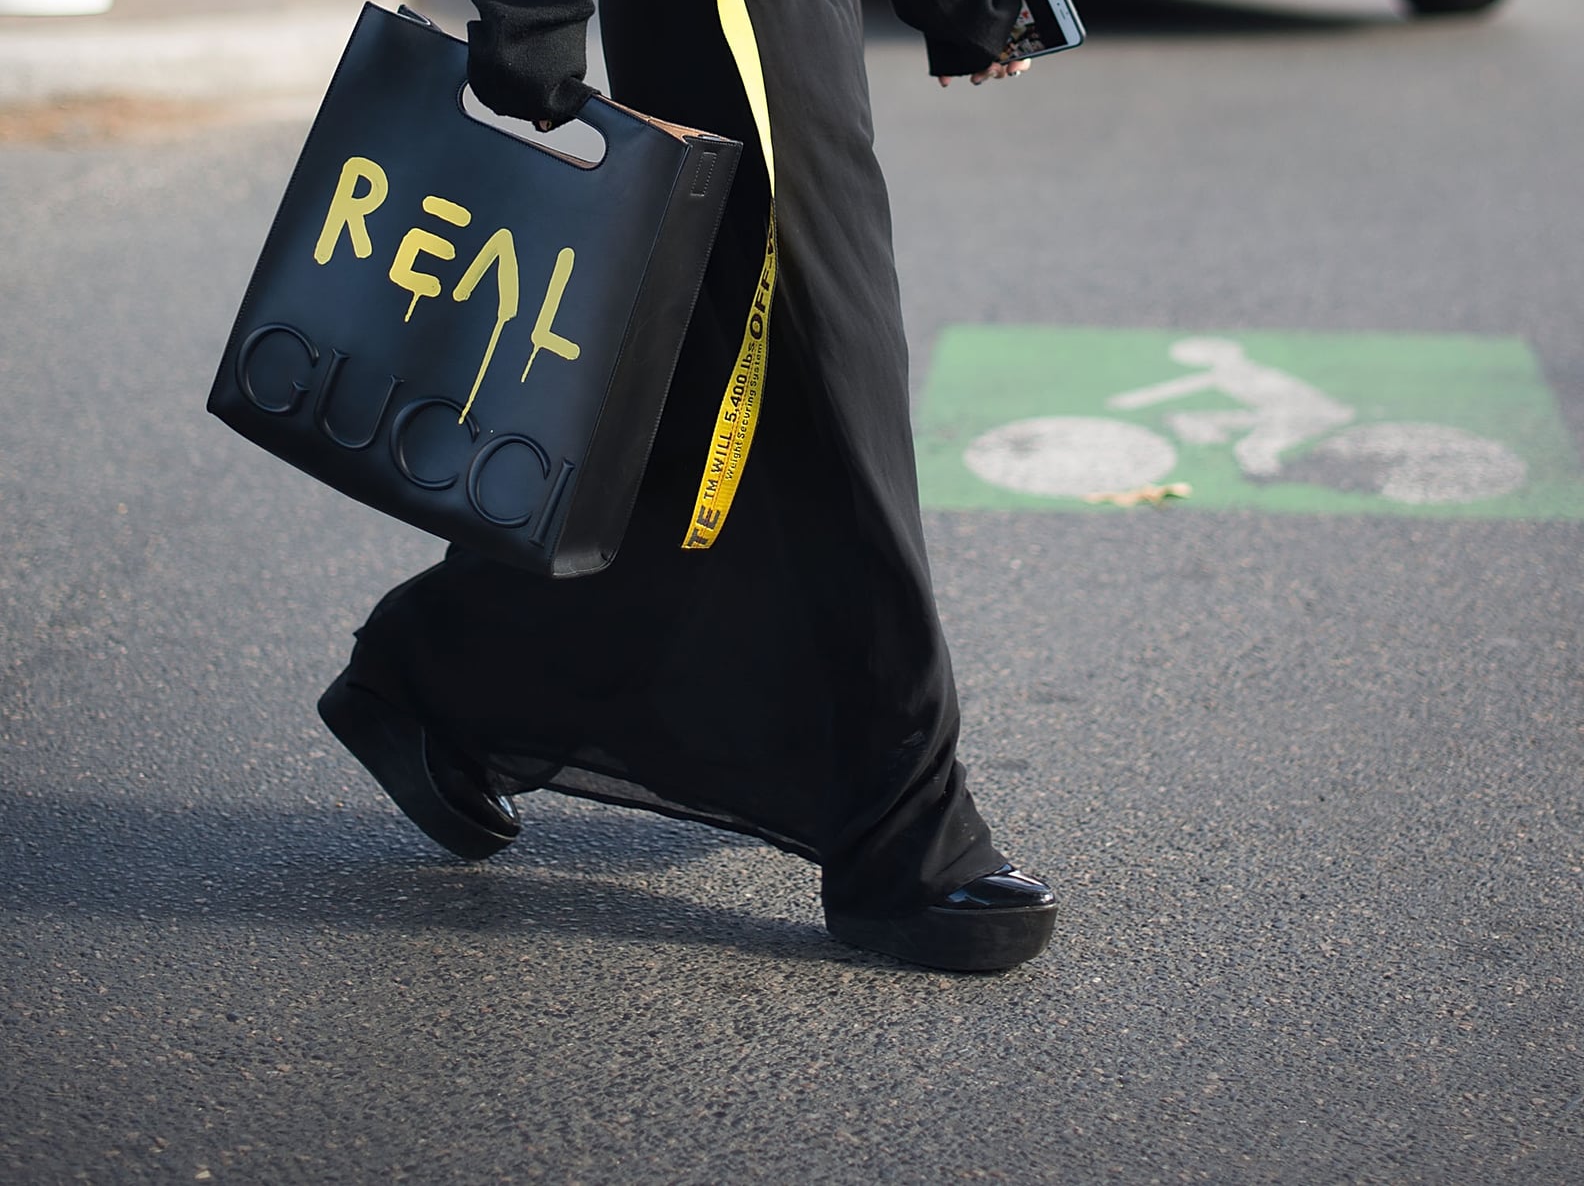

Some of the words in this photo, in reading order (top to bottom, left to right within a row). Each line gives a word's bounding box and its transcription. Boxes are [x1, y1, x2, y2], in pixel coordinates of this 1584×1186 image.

[313, 156, 581, 382] REAL
[234, 322, 577, 548] GUCCI
[710, 431, 733, 474] WILL
[724, 441, 743, 481] Weight
[735, 389, 757, 439] Securing
[749, 343, 763, 387] System
